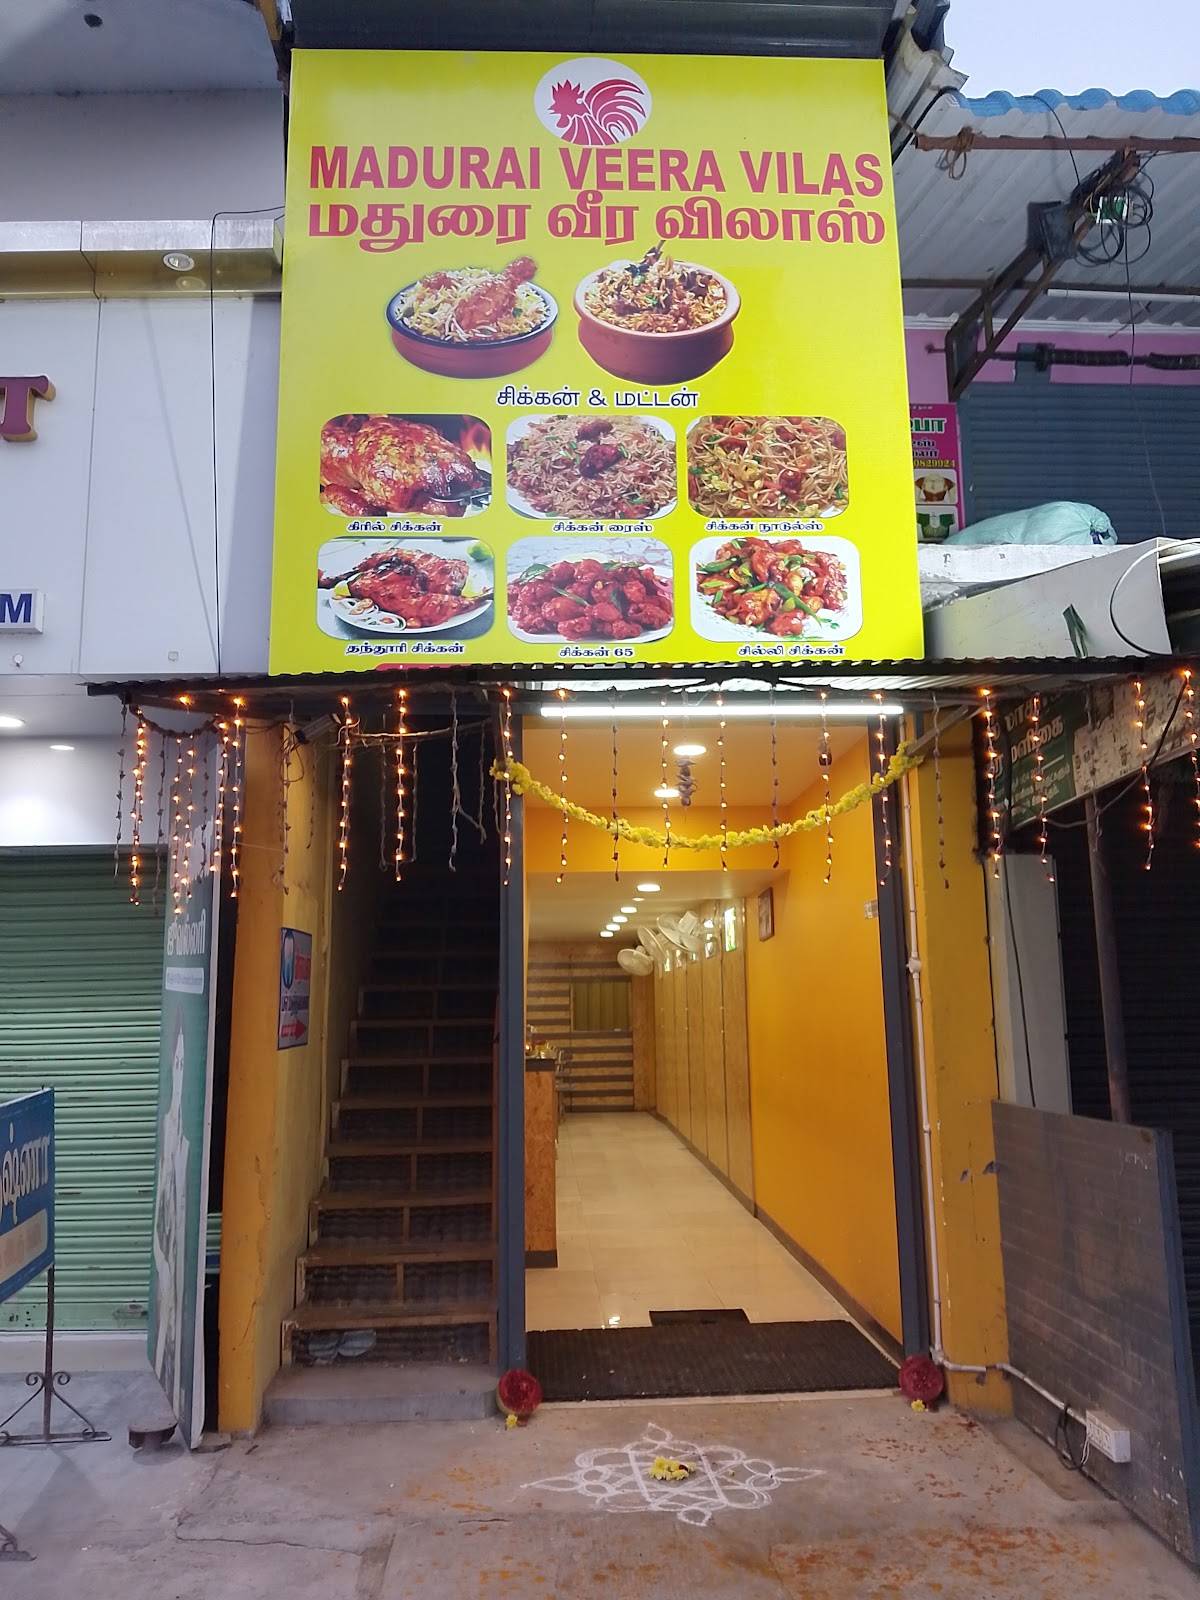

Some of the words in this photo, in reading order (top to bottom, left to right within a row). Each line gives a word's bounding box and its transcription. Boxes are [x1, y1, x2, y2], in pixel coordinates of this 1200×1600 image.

[309, 146, 541, 190] MADURAI
[559, 147, 726, 192] VEERA
[739, 150, 884, 197] VILAS
[308, 203, 532, 253] மதுரை
[547, 190, 640, 246] வீர
[655, 196, 886, 245] விலாஸ்
[496, 386, 581, 406] சிக்கன்
[588, 388, 608, 407] &
[615, 387, 699, 407] மட்டன்
[347, 521, 387, 533] கிரில்
[390, 521, 443, 533] சிக்கன்
[552, 521, 606, 534] சிக்கன்
[608, 522, 653, 534] ரைஸ்
[705, 520, 755, 532] சிக்கன்
[758, 520, 824, 533] நூடுல்ஸ்
[346, 641, 407, 655] தந்தூரி
[411, 641, 465, 654] சிக்கன்
[559, 645, 611, 658] சிக்கன்
[614, 647, 634, 658] 65
[738, 644, 785, 657] சில்லி
[788, 644, 845, 656] சிக்கன்
